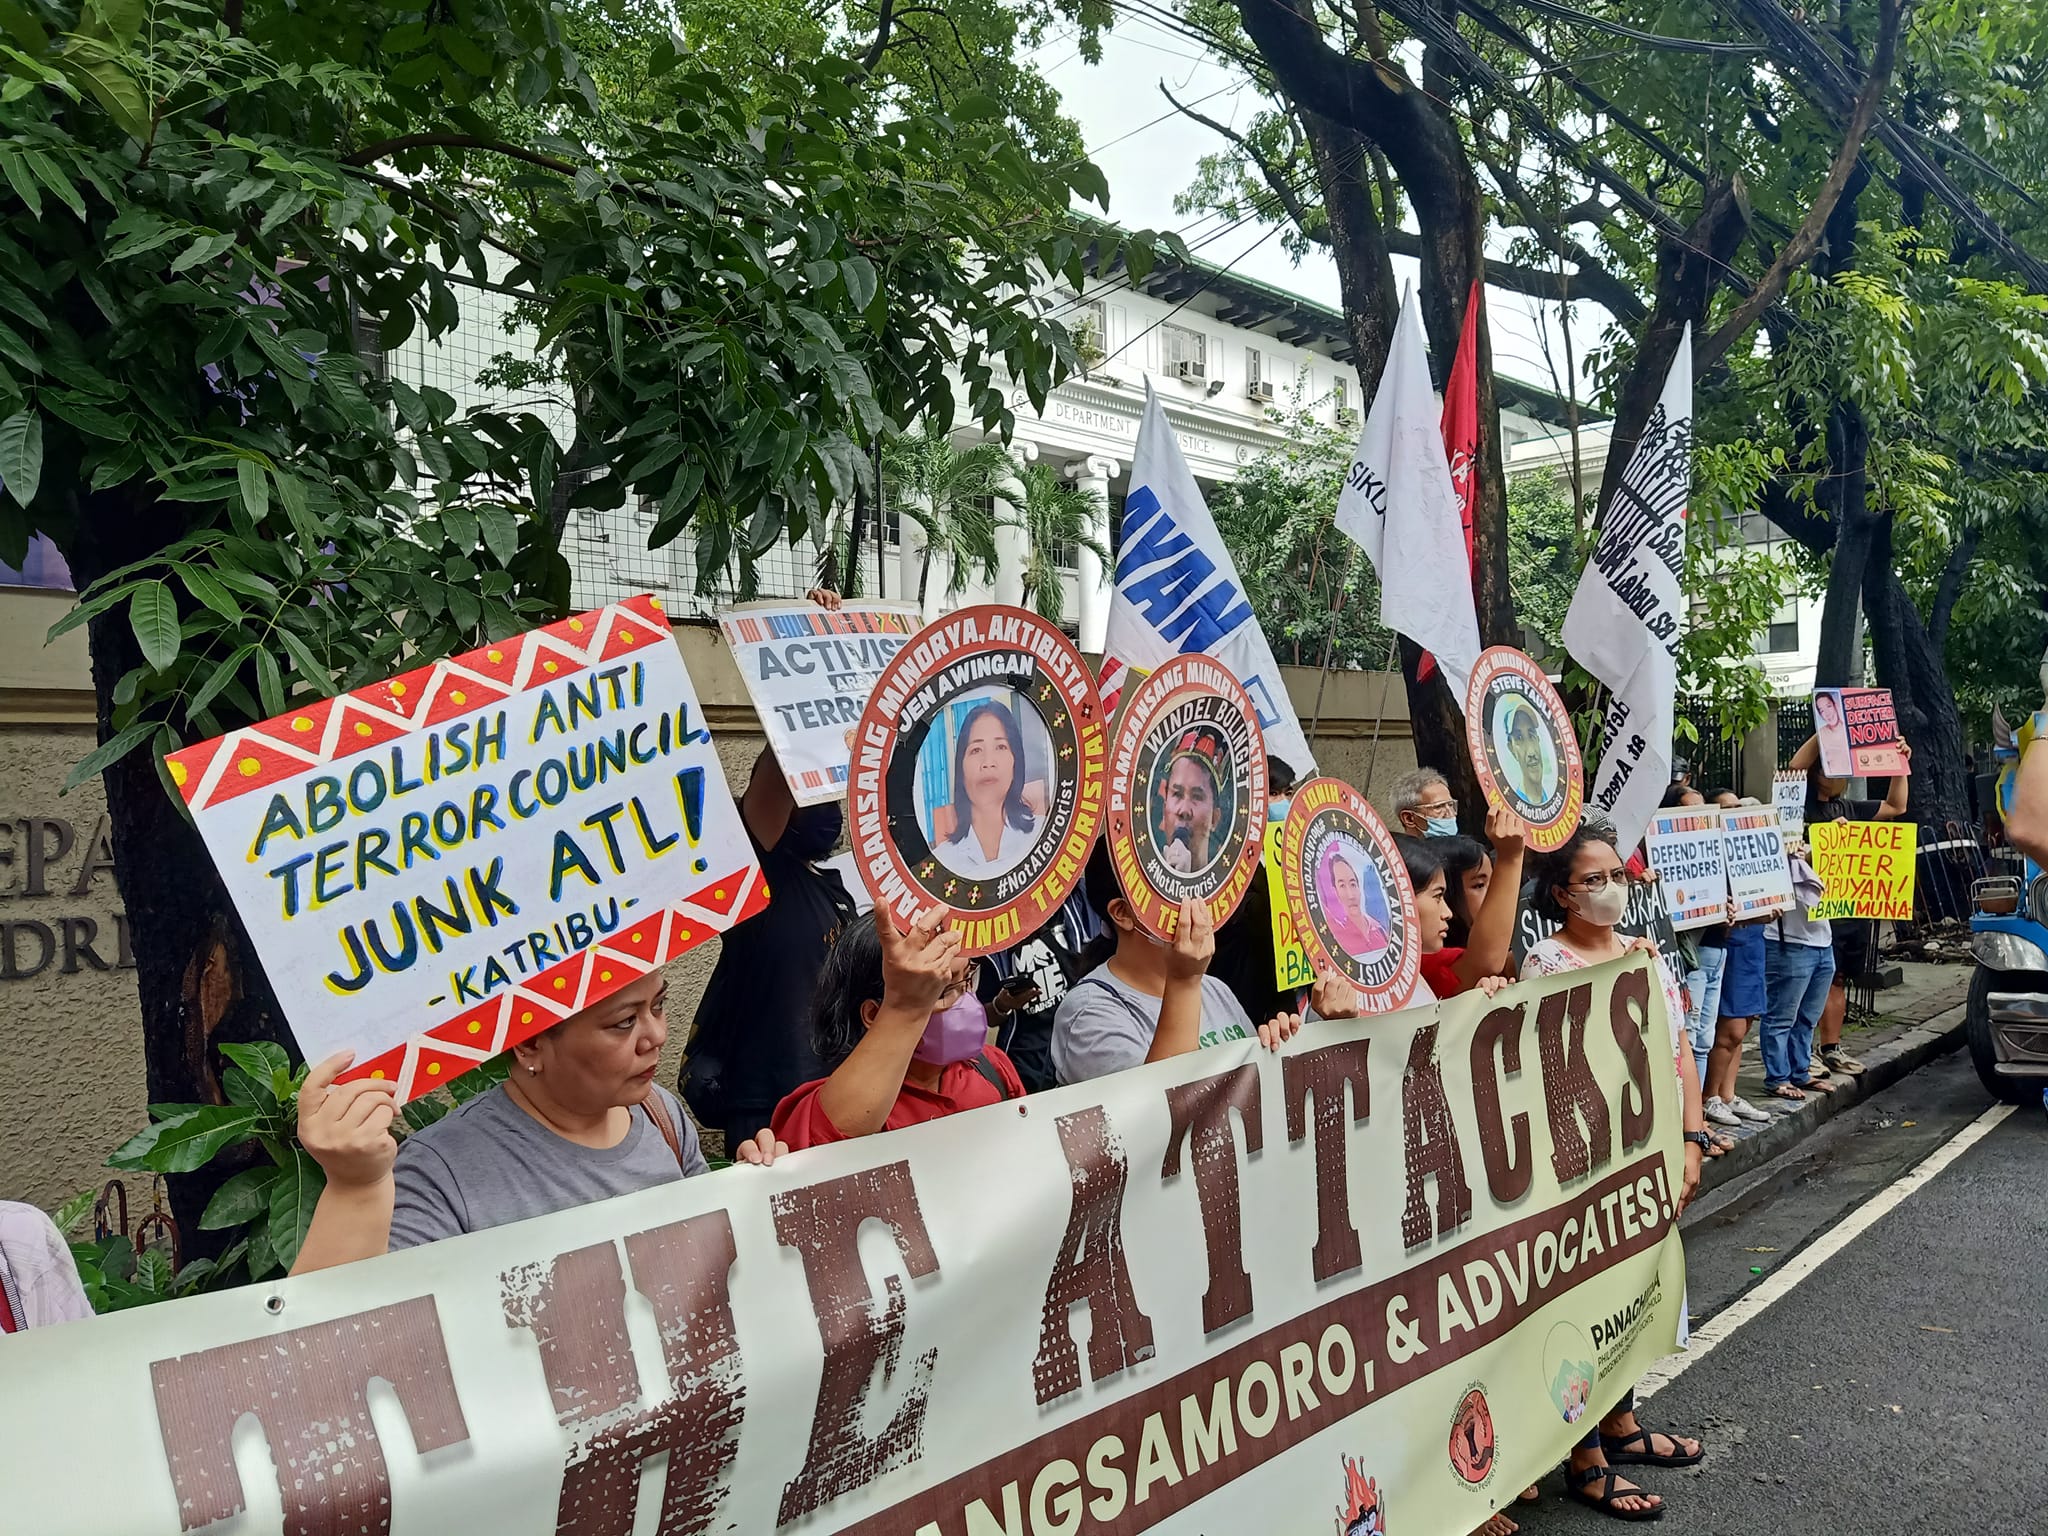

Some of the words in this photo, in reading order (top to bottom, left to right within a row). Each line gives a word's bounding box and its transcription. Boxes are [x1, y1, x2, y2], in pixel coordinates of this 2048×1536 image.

[1055, 402, 1132, 435] DEPARTMENT
[1175, 432, 1211, 454] USTICE
[758, 638, 909, 681] ACTIVIS
[877, 617, 986, 721] MINORYA,
[988, 615, 1090, 706] AKTIBISTA
[899, 686, 938, 733] JEN
[938, 653, 1035, 698] AWINGAN
[1491, 675, 1523, 694] STEVE
[1522, 680, 1553, 720] TAULI
[1843, 692, 1892, 710] SURFACE
[1846, 706, 1895, 724] DEXTER
[1144, 698, 1212, 754] WINDEL
[1214, 700, 1250, 789] BOLINGET
[1538, 680, 1579, 765] AKTIBISTA
[1849, 720, 1899, 745] NOW!
[246, 711, 507, 863] ABOLISH
[528, 661, 646, 745] ANTI
[1111, 664, 1184, 811] PAMBANSANG
[1246, 719, 1265, 842] AKTIBISTA
[1302, 783, 1340, 814] HINDI
[1530, 780, 1581, 848] TERORISTA!
[950, 907, 1021, 949] HINDI
[1031, 721, 1105, 913] TERORISTA!
[996, 778, 1075, 900] #NotATerrorist
[1350, 794, 1416, 918] PAMBANSANG
[1652, 842, 1697, 865] DEFEND
[1698, 839, 1721, 858] THE
[1724, 831, 1780, 862] DEFEND
[1818, 825, 1904, 852] SURFACE
[323, 856, 520, 995] JUNK
[550, 766, 708, 902] ATL!
[1115, 836, 1153, 915] HINDI
[1156, 858, 1251, 935] TEISTA!
[1147, 858, 1218, 898] #NotATerrorist
[1285, 810, 1321, 959] TERORISTA!
[1374, 854, 1395, 888] AM
[1729, 856, 1785, 878] CORDILLERA!
[1818, 853, 1894, 877] DEXTER
[1819, 875, 1909, 901] APUYAN!
[1389, 895, 1403, 928] AN
[1358, 930, 1402, 985] ACTIVIST
[148, 1159, 939, 1536] THE
[1034, 967, 1655, 1407] ATTACKS
[1385, 1294, 1430, 1364] &
[1437, 1165, 1672, 1345] ADVOCATES!
